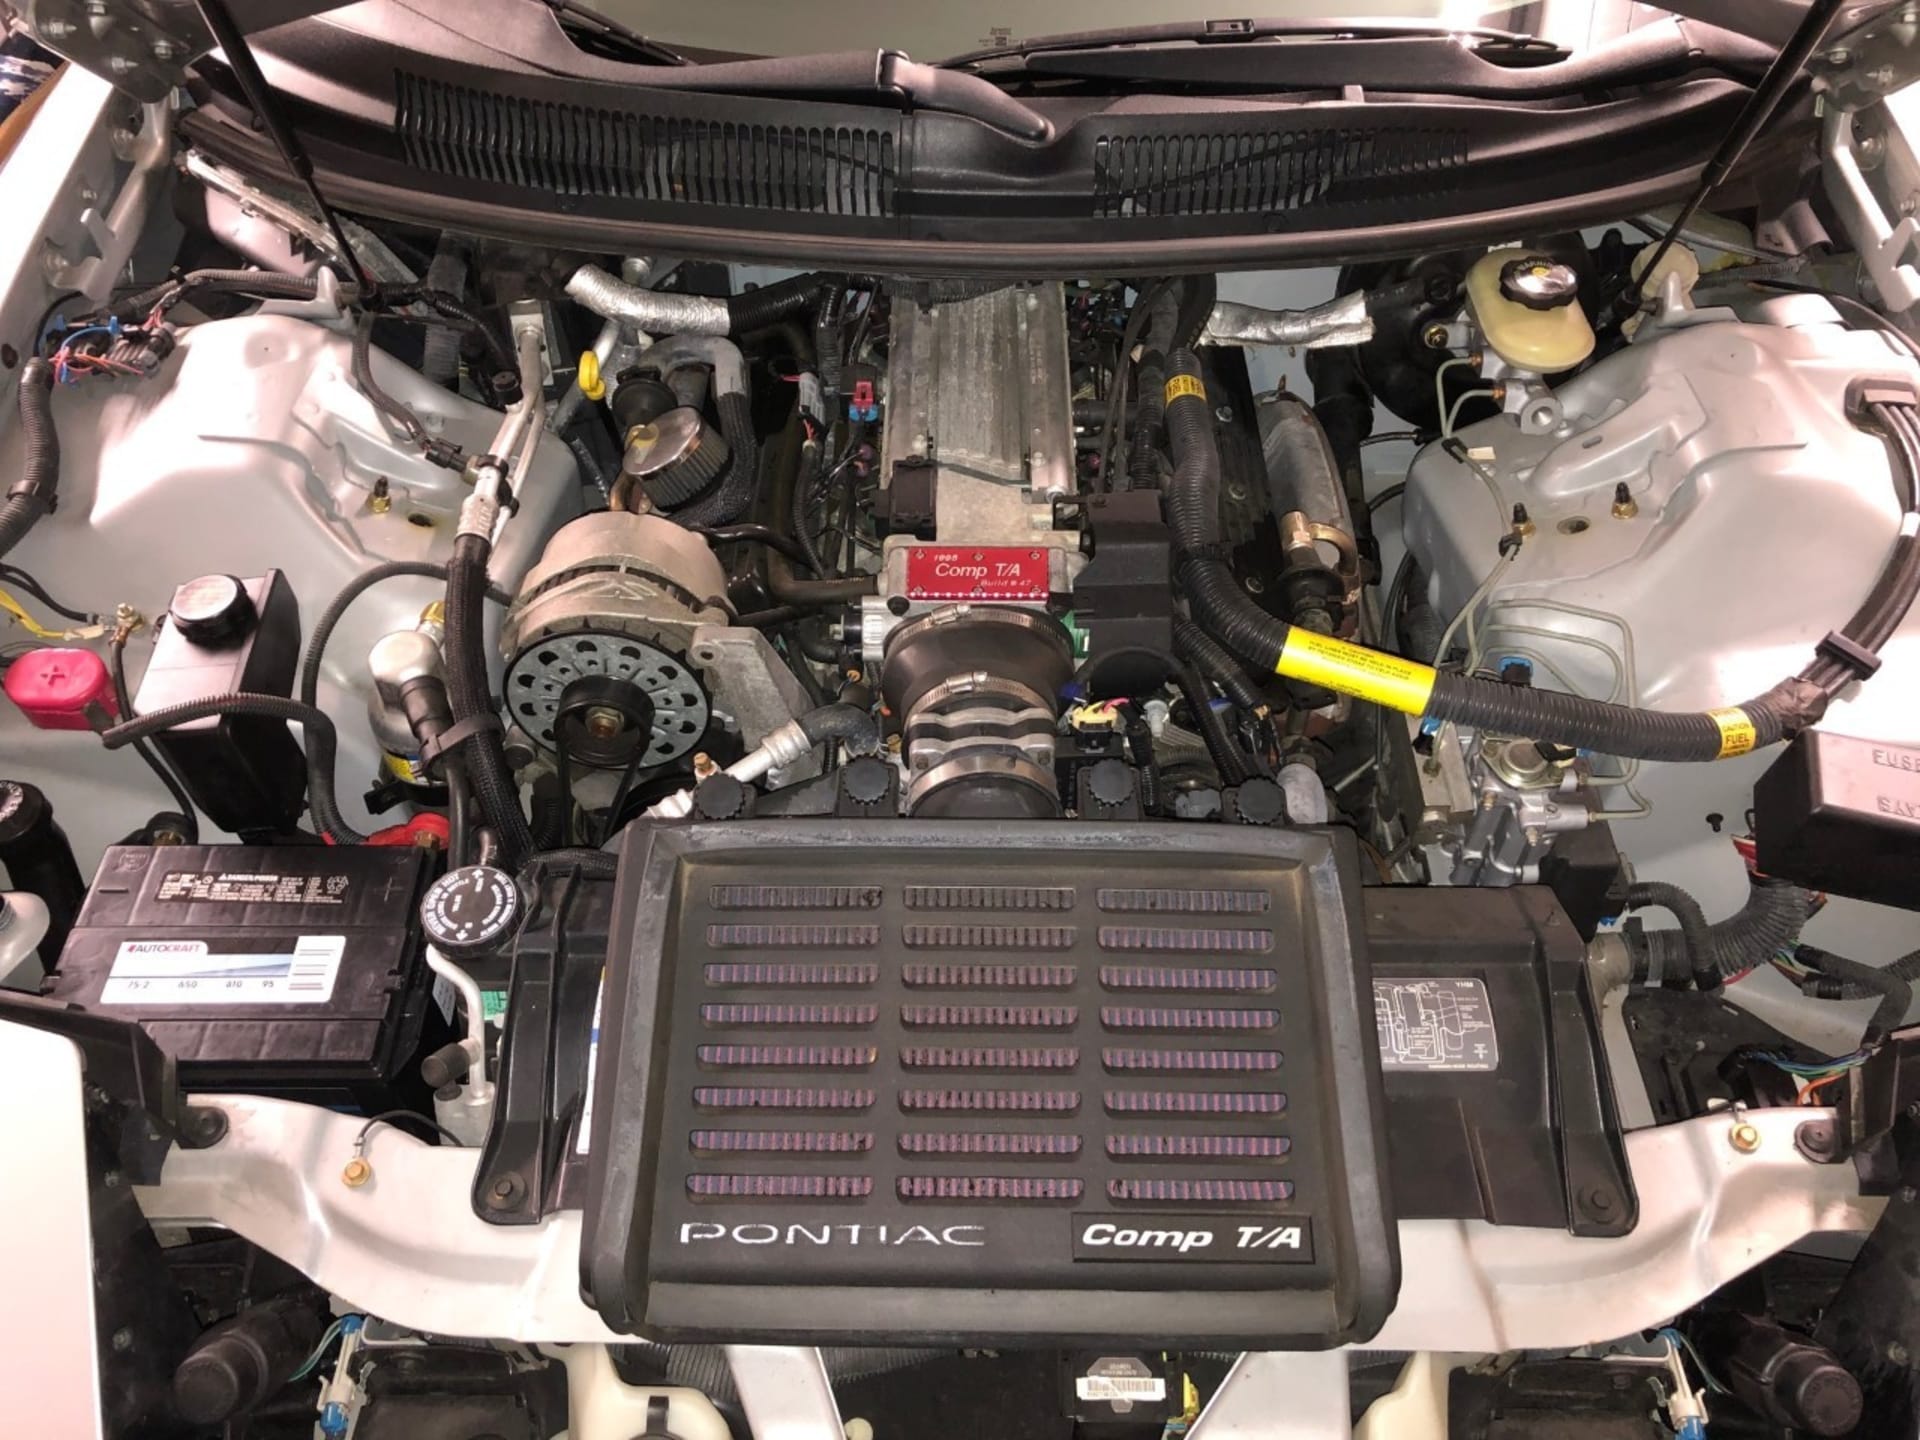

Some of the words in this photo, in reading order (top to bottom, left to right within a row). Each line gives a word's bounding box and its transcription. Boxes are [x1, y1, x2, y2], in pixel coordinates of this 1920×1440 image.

[935, 563, 988, 580] Comp
[995, 563, 1021, 577] T/A
[1725, 732, 1750, 745] FUEL
[134, 944, 201, 953] AUTOCRAFT
[680, 1222, 985, 1246] PONTIAC
[1081, 1224, 1213, 1253] Comp
[1236, 1225, 1303, 1249] T/A
